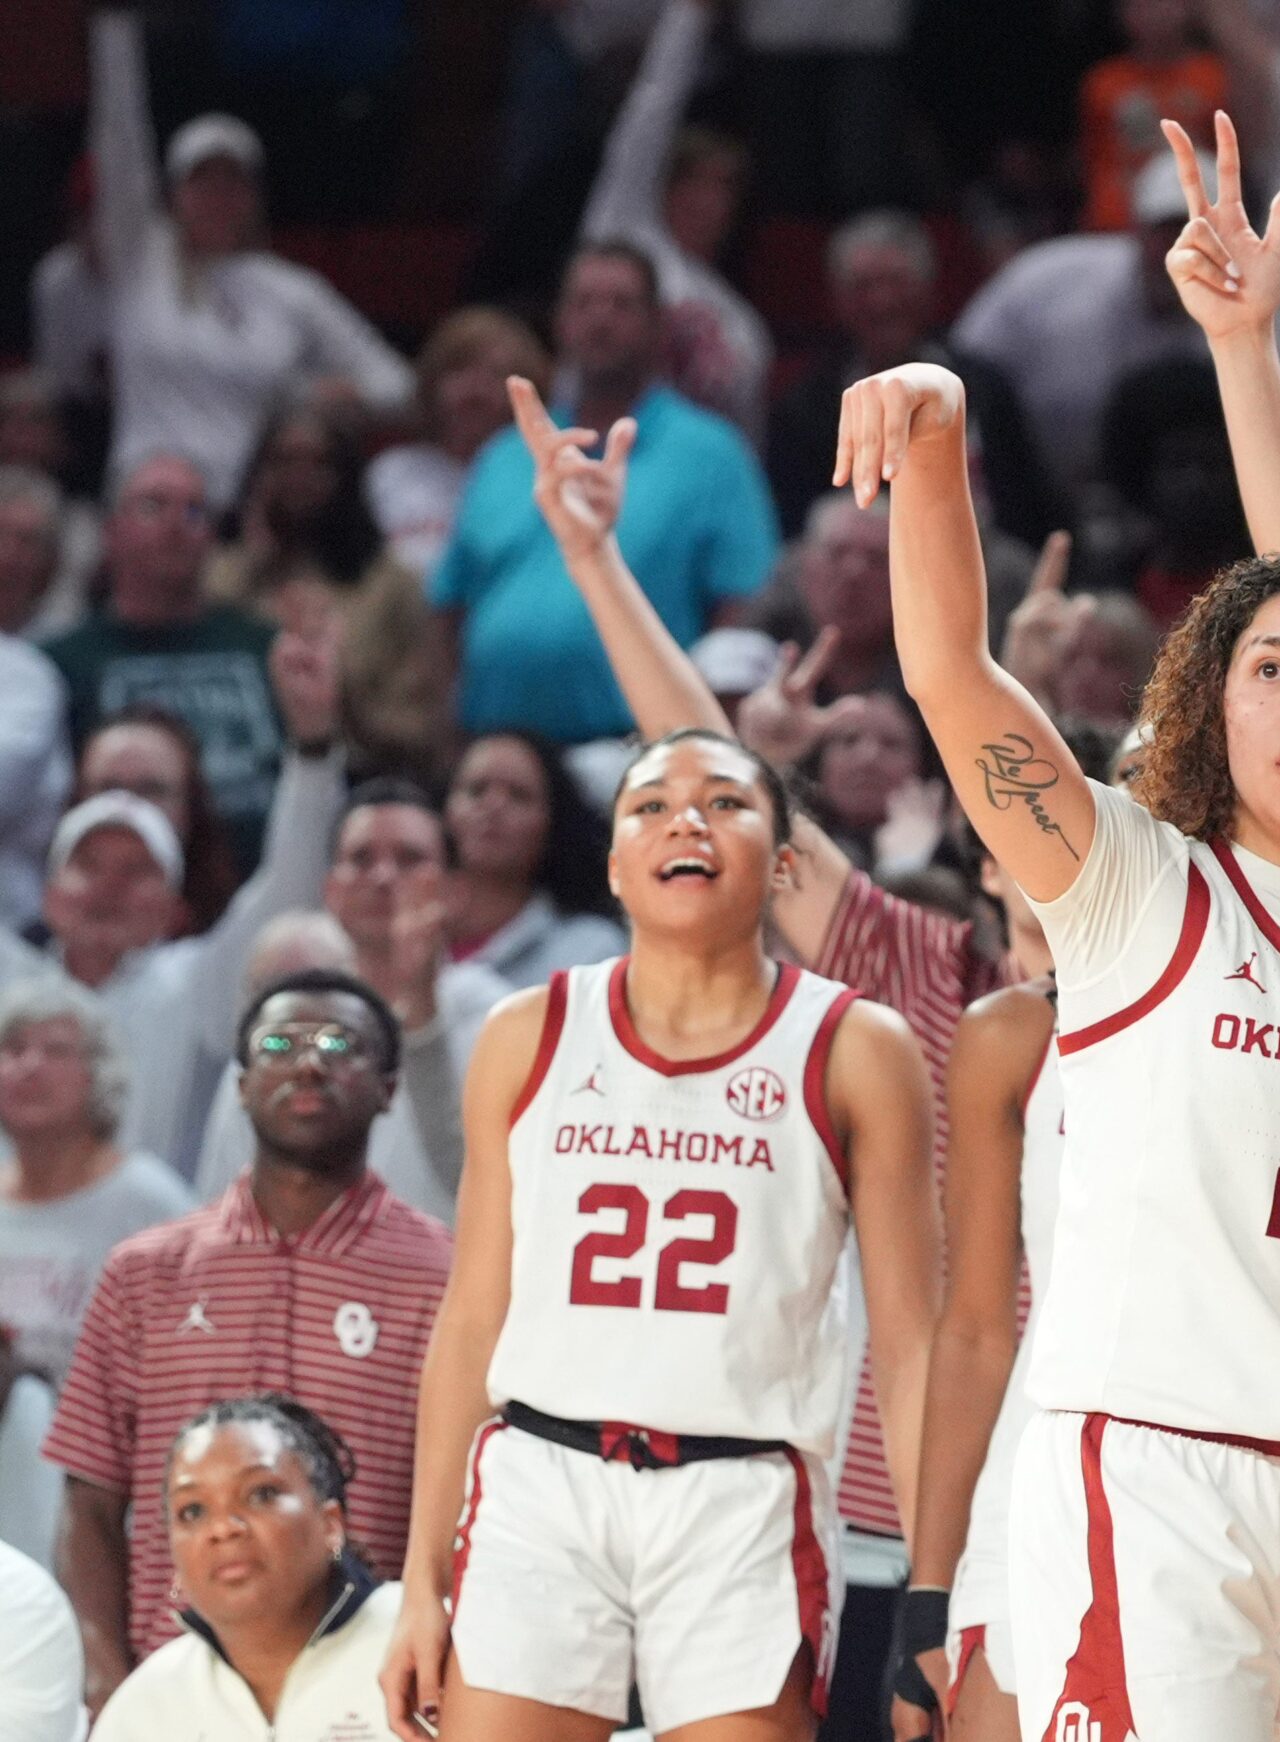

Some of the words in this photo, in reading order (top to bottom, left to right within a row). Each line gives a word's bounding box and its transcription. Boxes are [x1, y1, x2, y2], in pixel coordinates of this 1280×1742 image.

[727, 1067, 785, 1120] SEC
[554, 1123, 775, 1172] OKLAHOMA
[569, 1183, 738, 1314] 22
